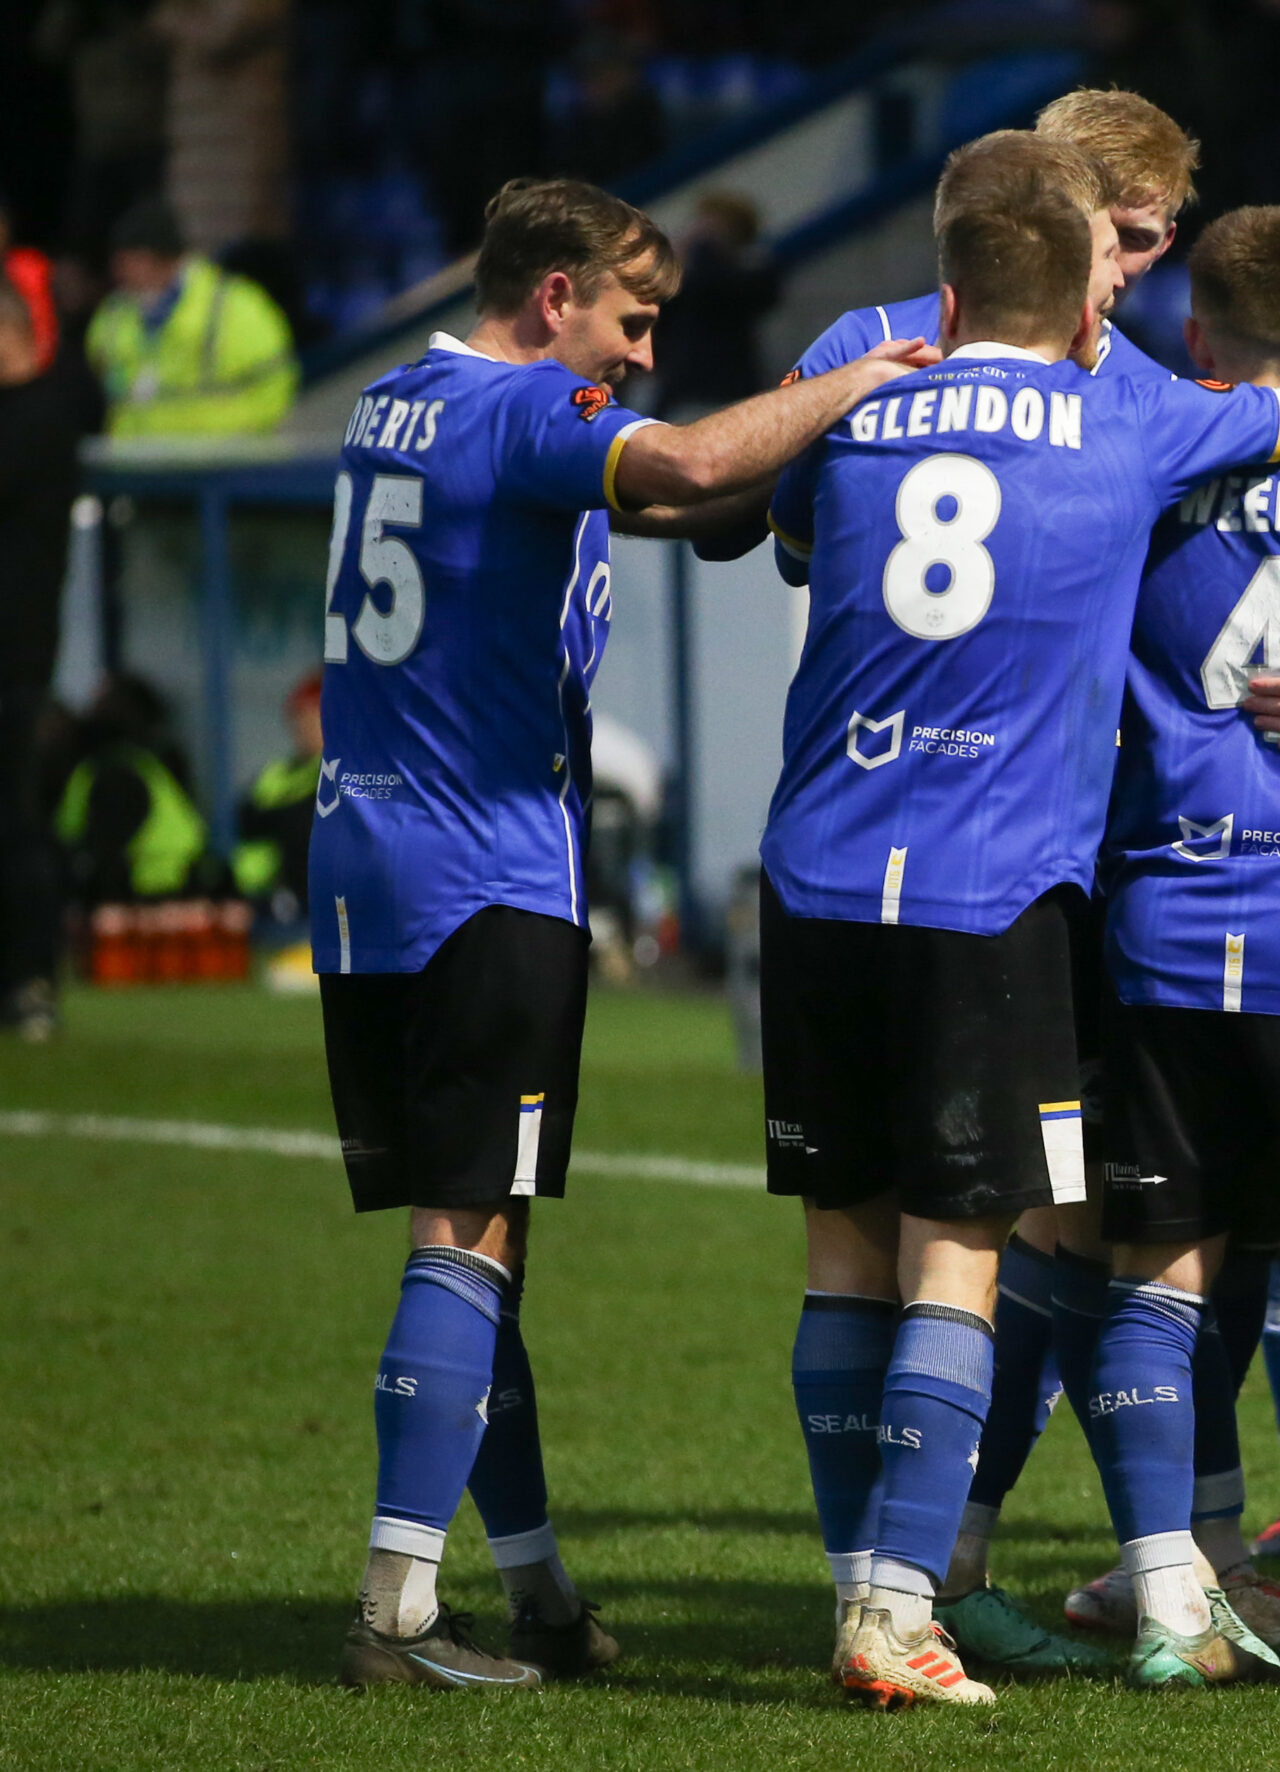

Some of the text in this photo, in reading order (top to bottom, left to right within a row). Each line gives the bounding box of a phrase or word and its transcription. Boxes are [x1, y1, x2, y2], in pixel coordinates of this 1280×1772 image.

[344, 394, 445, 451] OBERTS
[852, 384, 1082, 450] GLENDON
[882, 452, 1002, 641] 8
[912, 726, 995, 746] PRECISION
[909, 740, 979, 759] FACADES
[341, 772, 403, 786] PRECISION
[339, 784, 392, 800] FACADES
[375, 1374, 418, 1397] ALS
[1089, 1386, 1180, 1418] SEALS
[808, 1414, 880, 1433] SEAL
[876, 1425, 922, 1449] ALS
